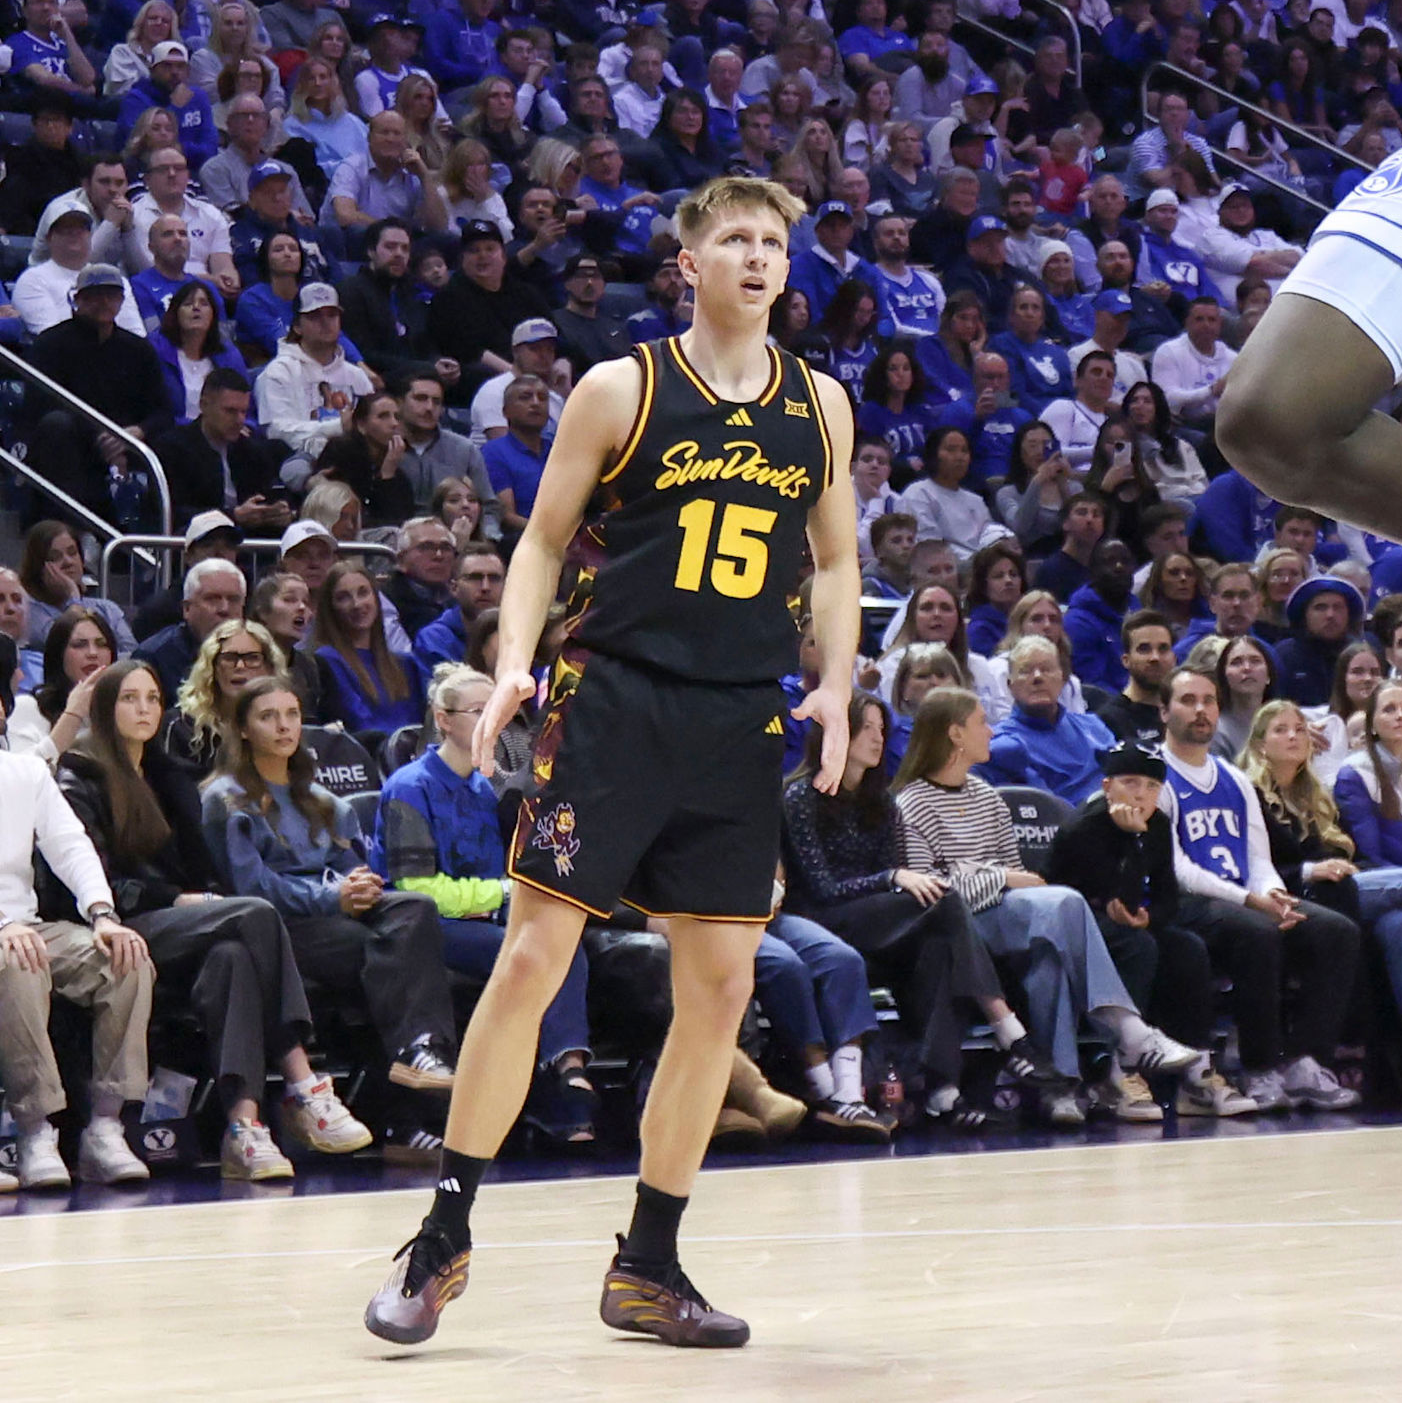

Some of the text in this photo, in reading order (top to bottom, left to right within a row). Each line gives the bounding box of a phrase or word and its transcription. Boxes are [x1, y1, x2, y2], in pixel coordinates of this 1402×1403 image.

[674, 498, 778, 599] 15
[315, 764, 369, 784] HIRE
[1014, 825, 1059, 843] PPHI
[1185, 807, 1241, 843] BYU
